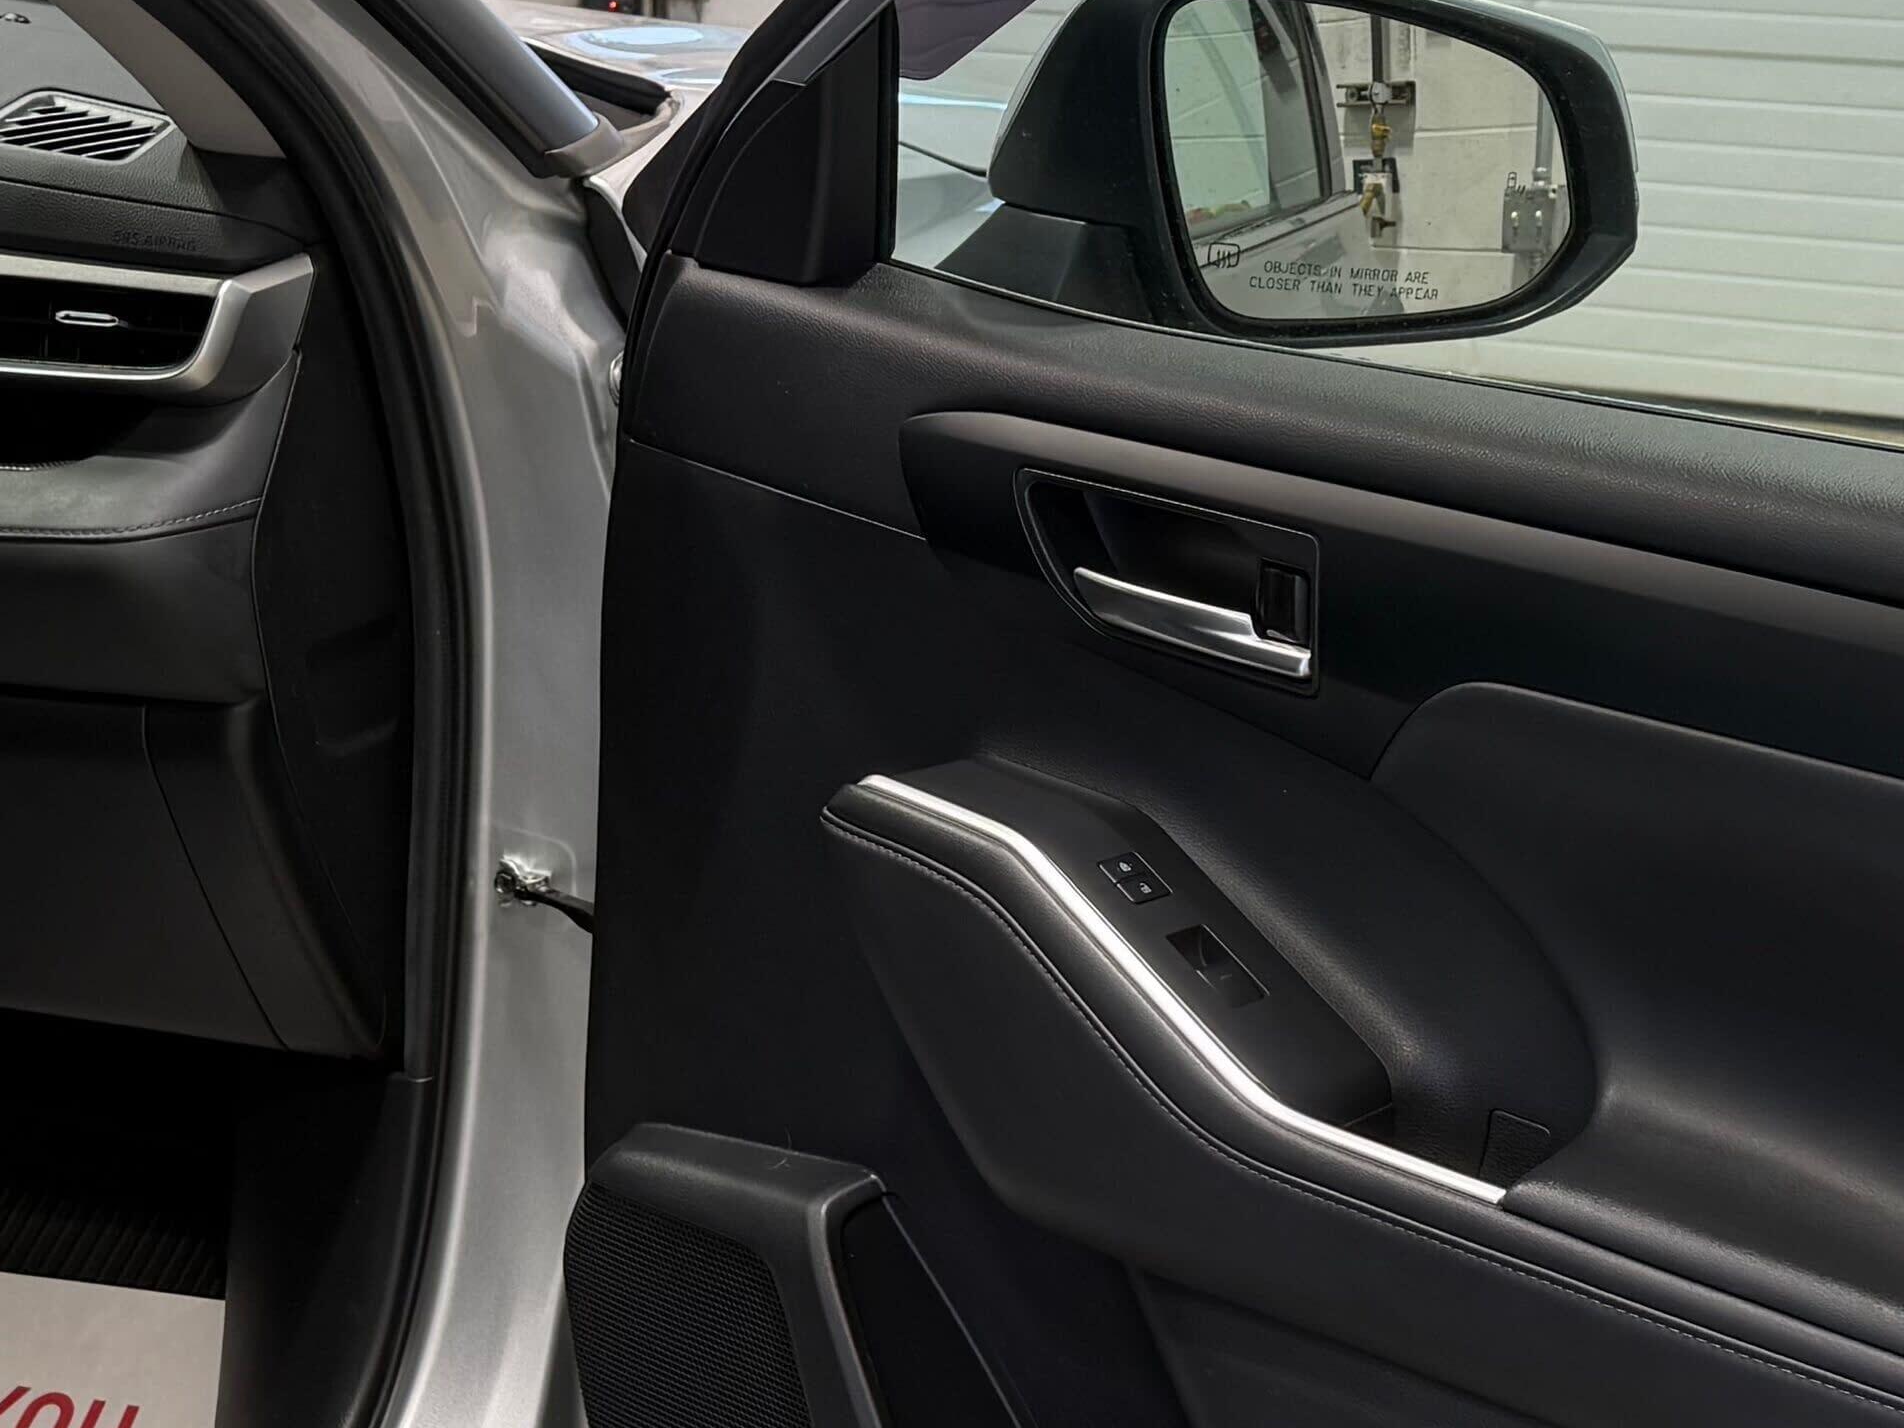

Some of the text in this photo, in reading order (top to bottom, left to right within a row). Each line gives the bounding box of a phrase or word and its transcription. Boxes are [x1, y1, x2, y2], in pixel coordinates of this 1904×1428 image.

[1264, 260, 1430, 285] OBJECTS IN MIRROR ARE
[1249, 276, 1439, 300] CLOSER THAN THEY APPEAR
